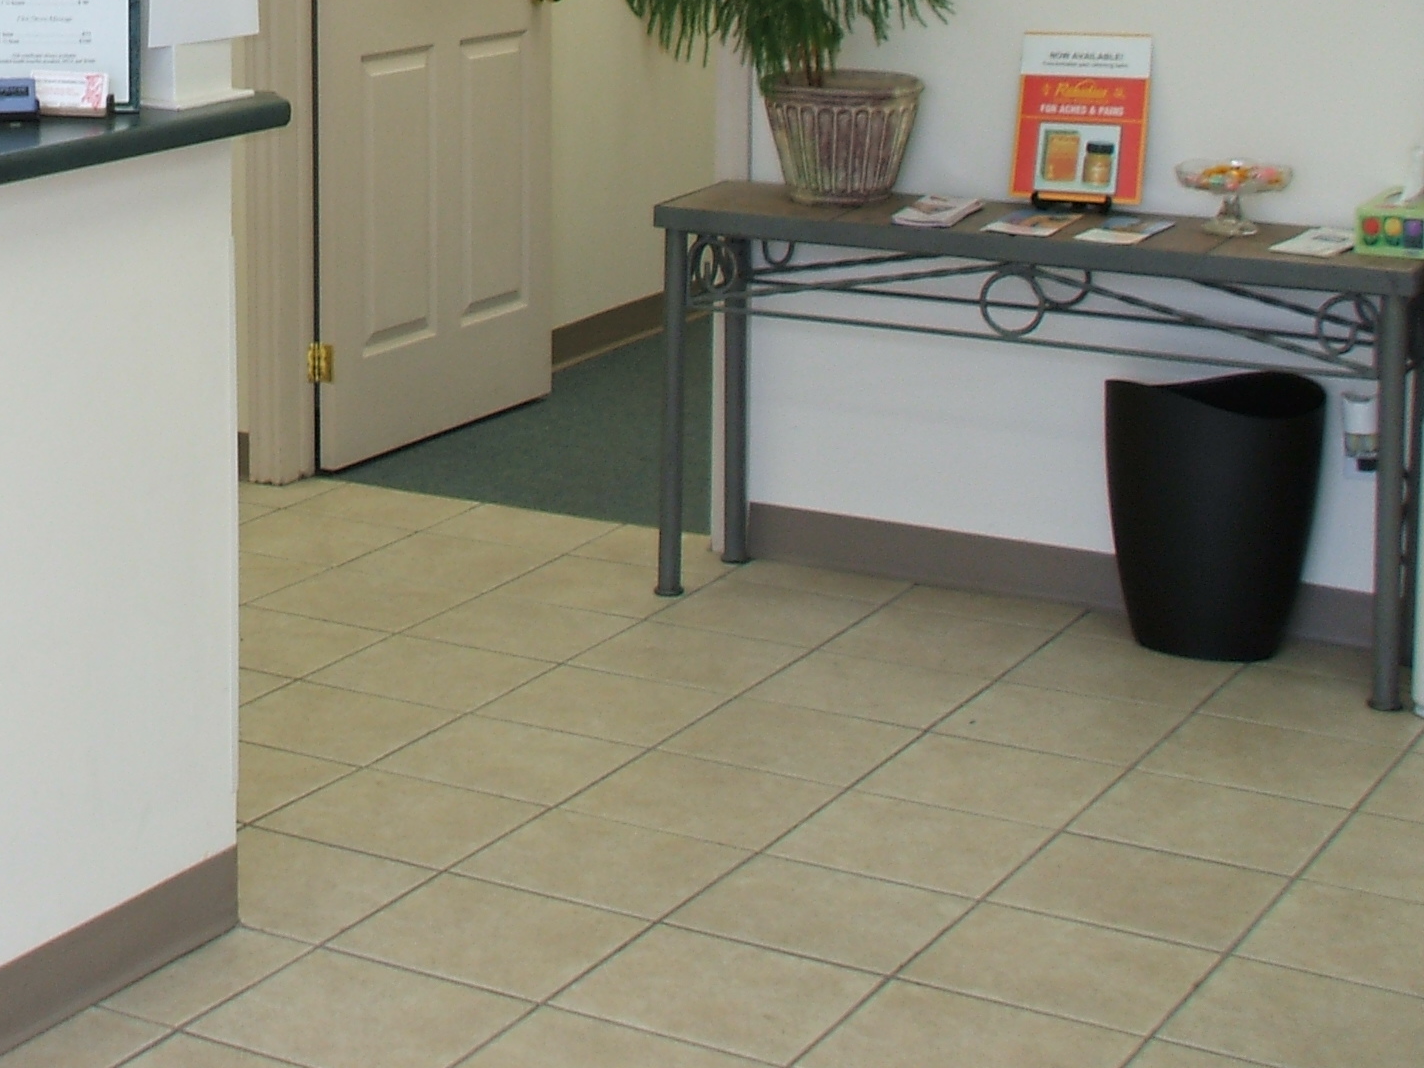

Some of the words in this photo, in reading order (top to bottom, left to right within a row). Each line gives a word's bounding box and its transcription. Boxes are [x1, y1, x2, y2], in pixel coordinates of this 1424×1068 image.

[1049, 51, 1070, 59] NOW
[1040, 103, 1057, 114] FOR
[1058, 104, 1087, 115] ACHES
